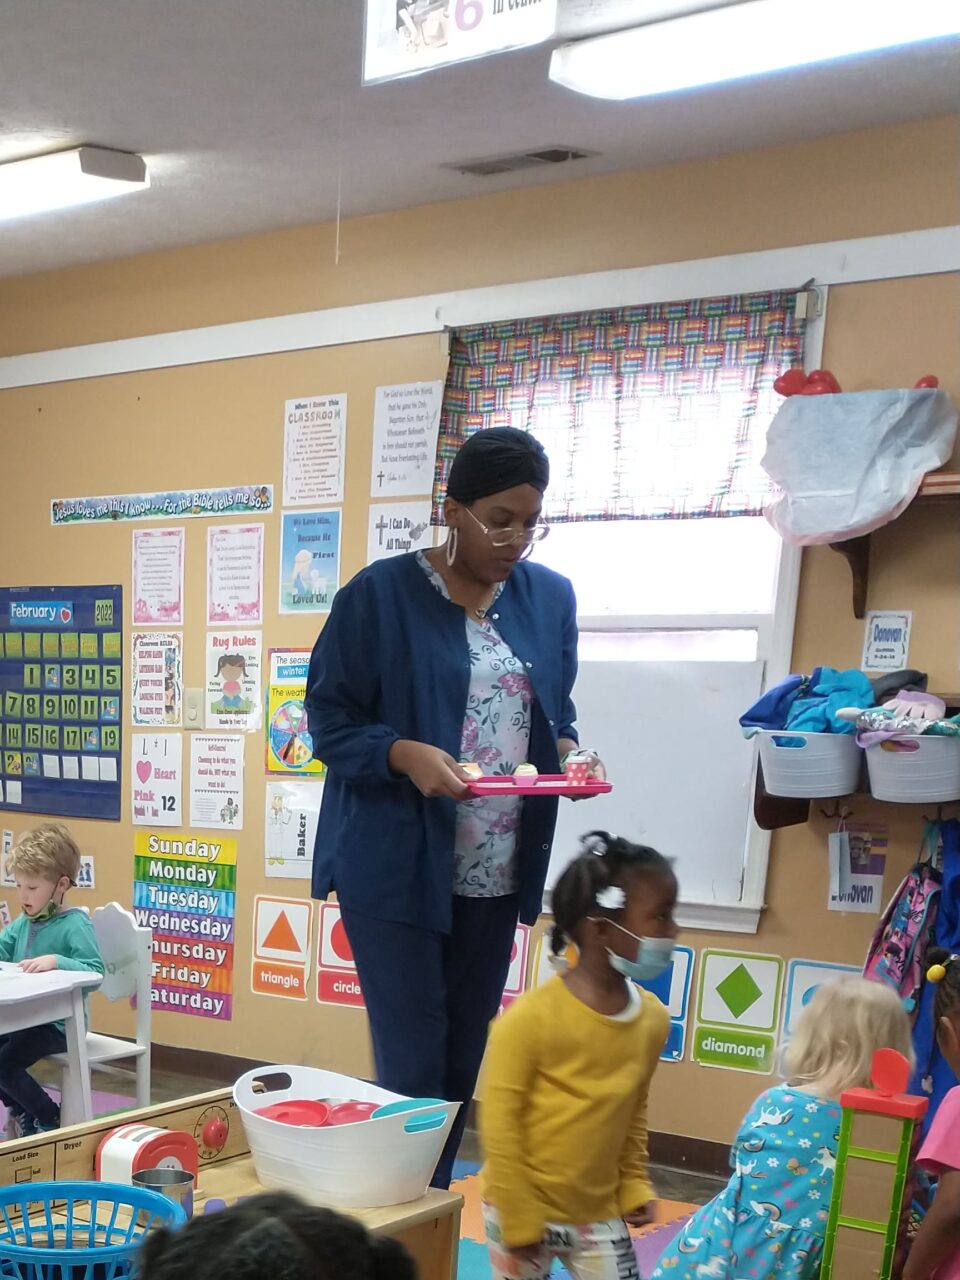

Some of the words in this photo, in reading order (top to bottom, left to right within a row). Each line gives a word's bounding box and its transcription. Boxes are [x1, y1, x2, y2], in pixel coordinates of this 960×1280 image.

[288, 409, 341, 424] CLASSROOM
[56, 504, 75, 521] Jesus
[75, 502, 95, 519] loves
[96, 503, 109, 517] me
[110, 499, 125, 513] this
[125, 502, 130, 515] I
[179, 497, 192, 509] the
[193, 492, 214, 510] Bible
[214, 494, 234, 510] tells
[235, 492, 249, 504] me
[303, 517, 316, 525] Love
[389, 518, 393, 530] I
[393, 518, 404, 529] Can
[404, 518, 411, 529] Do
[298, 533, 321, 543] Because
[386, 538, 394, 550] All
[394, 538, 412, 552] Things
[313, 551, 335, 559] First
[293, 593, 314, 605] Loved
[316, 593, 328, 603] Us!
[10, 602, 57, 621] February
[96, 603, 113, 622] 2022
[212, 636, 230, 650] Rug
[232, 634, 257, 647] Rules
[276, 656, 287, 664] The
[29, 667, 34, 685] 1
[65, 668, 76, 685] 3
[85, 669, 96, 685] 4
[106, 668, 118, 685] 5
[282, 667, 305, 675] winter
[272, 687, 284, 696] The
[8, 696, 18, 712] 7
[26, 697, 36, 714] 8
[45, 698, 56, 715] 9
[64, 699, 76, 715] 10
[83, 700, 95, 715] 11
[8, 727, 19, 744] 14
[27, 727, 39, 744] 15
[45, 729, 57, 745] 16
[66, 730, 78, 746] 17
[104, 730, 116, 746] 19
[154, 767, 176, 780] Heart
[134, 789, 155, 801] Pink
[161, 795, 176, 812] 12
[297, 812, 307, 857] Baker
[148, 834, 221, 862] Sunday
[149, 860, 218, 887] Monday
[148, 886, 219, 913] Tuesday
[134, 909, 232, 942] Wednesday
[151, 937, 227, 966] hursday
[151, 962, 211, 989] Friday
[260, 970, 300, 988] triangle
[333, 980, 361, 994] circle
[151, 988, 224, 1016] aturday
[701, 1036, 766, 1058] diamond
[63, 1140, 83, 1151] Dryer
[12, 1153, 27, 1163] Load
[27, 1151, 39, 1160] Size
